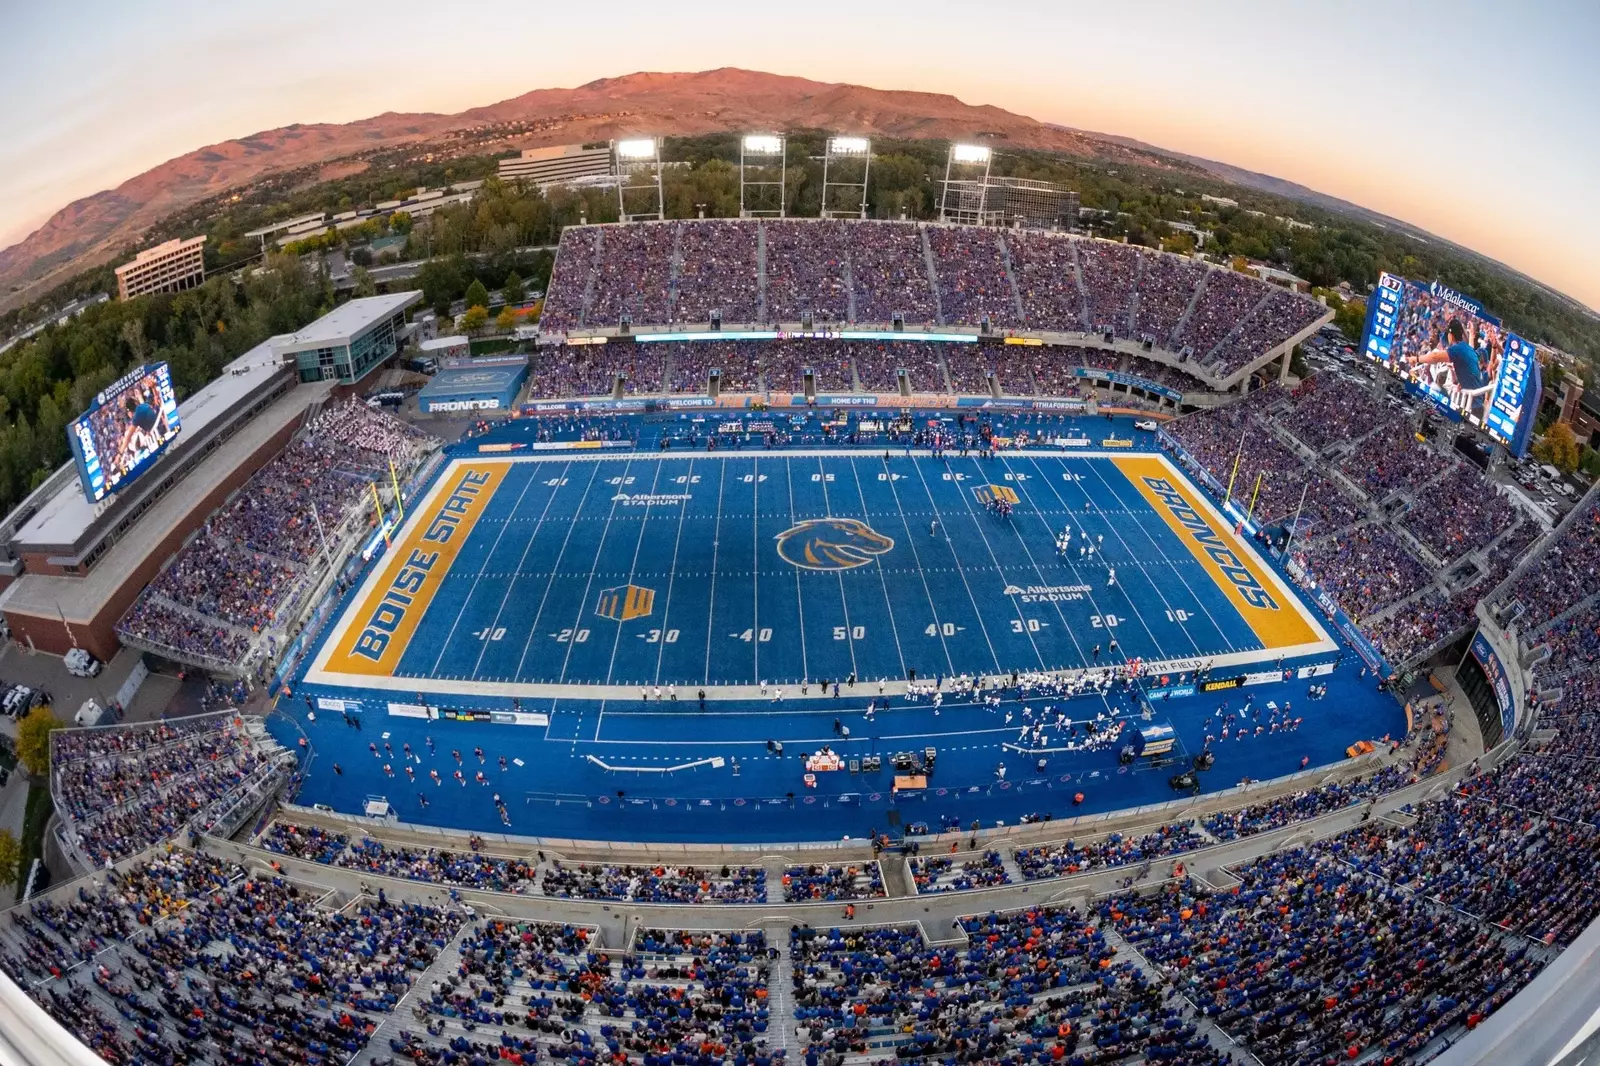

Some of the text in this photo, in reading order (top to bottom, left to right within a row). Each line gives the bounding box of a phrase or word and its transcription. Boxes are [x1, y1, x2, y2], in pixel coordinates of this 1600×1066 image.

[1437, 286, 1478, 314] Melaleuca
[104, 377, 125, 395] DOUBLE
[428, 399, 500, 412] BRONCOS
[1140, 476, 1281, 611] BRONCOS
[348, 548, 441, 662] BOISE
[421, 469, 491, 544] STATE
[1025, 585, 1092, 594] Albertsons
[1021, 592, 1084, 603] STADIUM
[1090, 614, 1118, 628] 20
[1165, 609, 1188, 622] 10
[924, 623, 955, 637] 40
[1010, 619, 1040, 632] 30
[479, 627, 506, 641] 10
[557, 629, 590, 643] 20
[646, 629, 680, 643] 30
[740, 628, 773, 642] 40
[833, 626, 865, 640] 50
[1170, 660, 1203, 670] FIELD
[1174, 688, 1194, 697] WORLD
[1205, 680, 1237, 691] KENDALL
